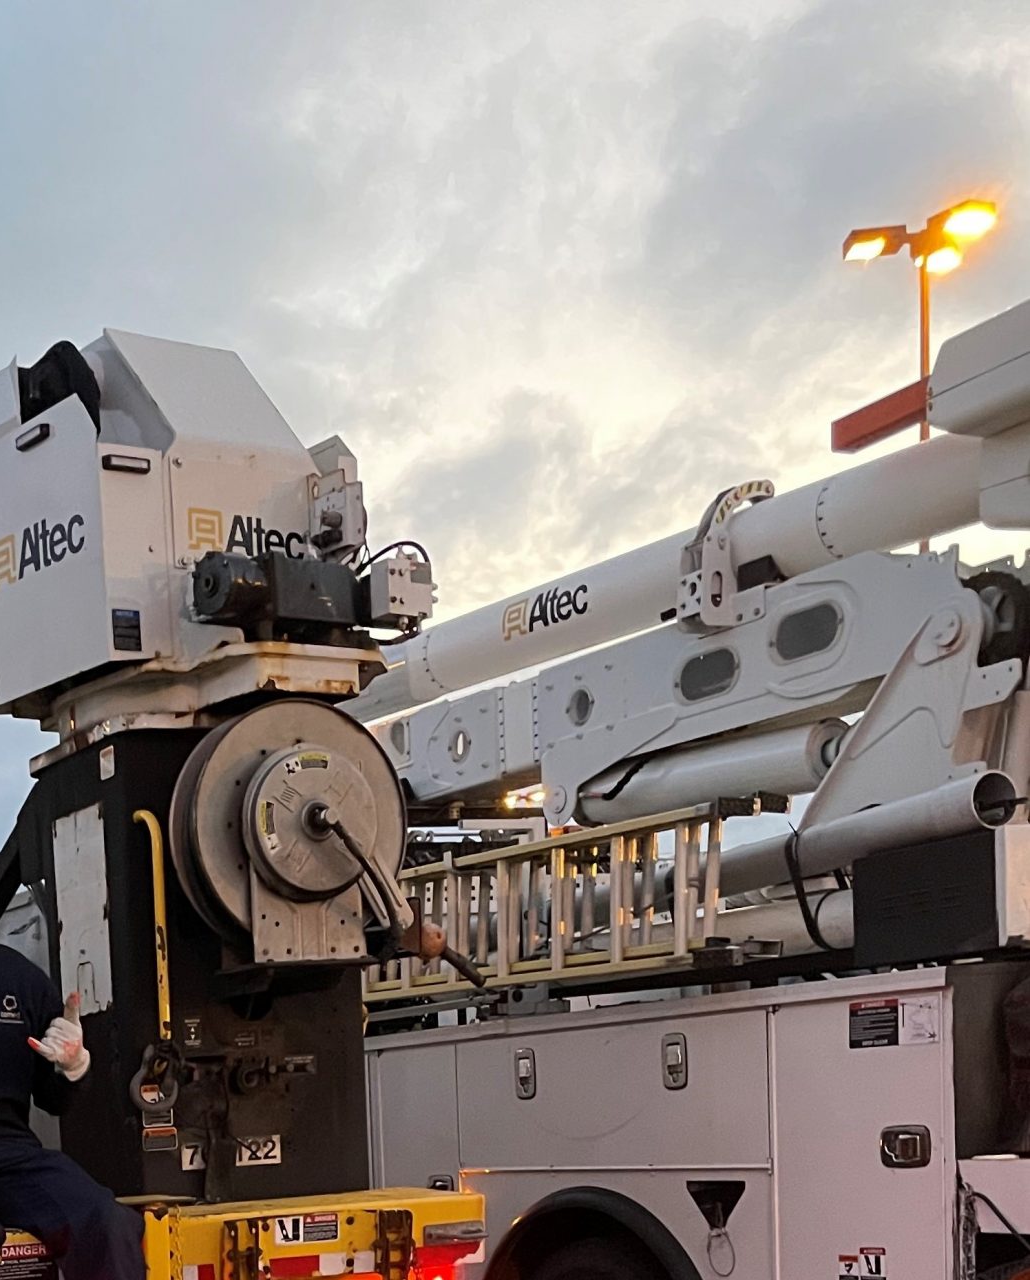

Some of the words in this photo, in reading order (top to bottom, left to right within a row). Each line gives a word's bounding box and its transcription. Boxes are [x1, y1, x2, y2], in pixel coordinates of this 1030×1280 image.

[18, 514, 85, 580] Altec
[226, 514, 305, 560] Altec
[529, 584, 588, 632] Altec
[1, 1245, 47, 1258] DANGER
